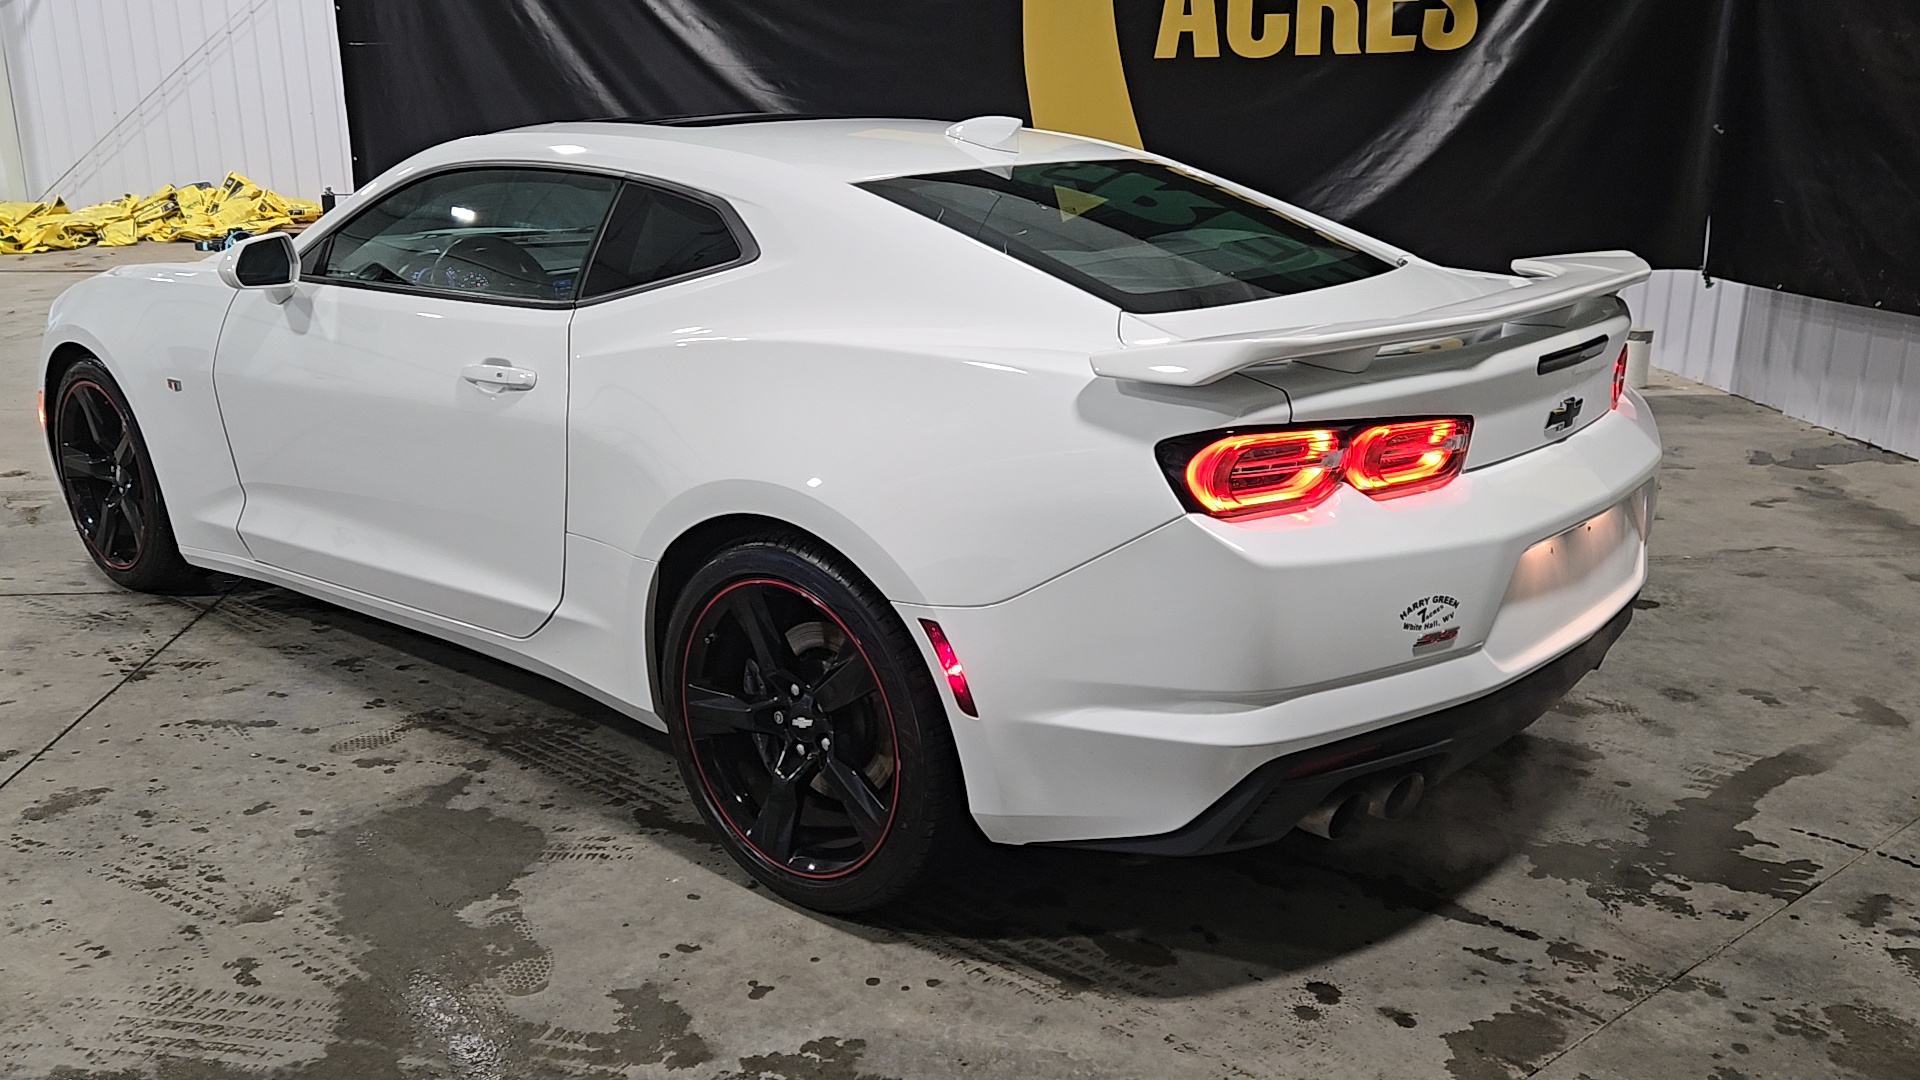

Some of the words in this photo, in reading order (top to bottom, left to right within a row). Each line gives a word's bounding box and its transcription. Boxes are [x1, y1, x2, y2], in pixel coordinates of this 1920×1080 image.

[1400, 597, 1430, 620] HARRY
[1432, 595, 1460, 609] GREEN
[1417, 607, 1427, 623] 7
[1442, 611, 1454, 623] WV
